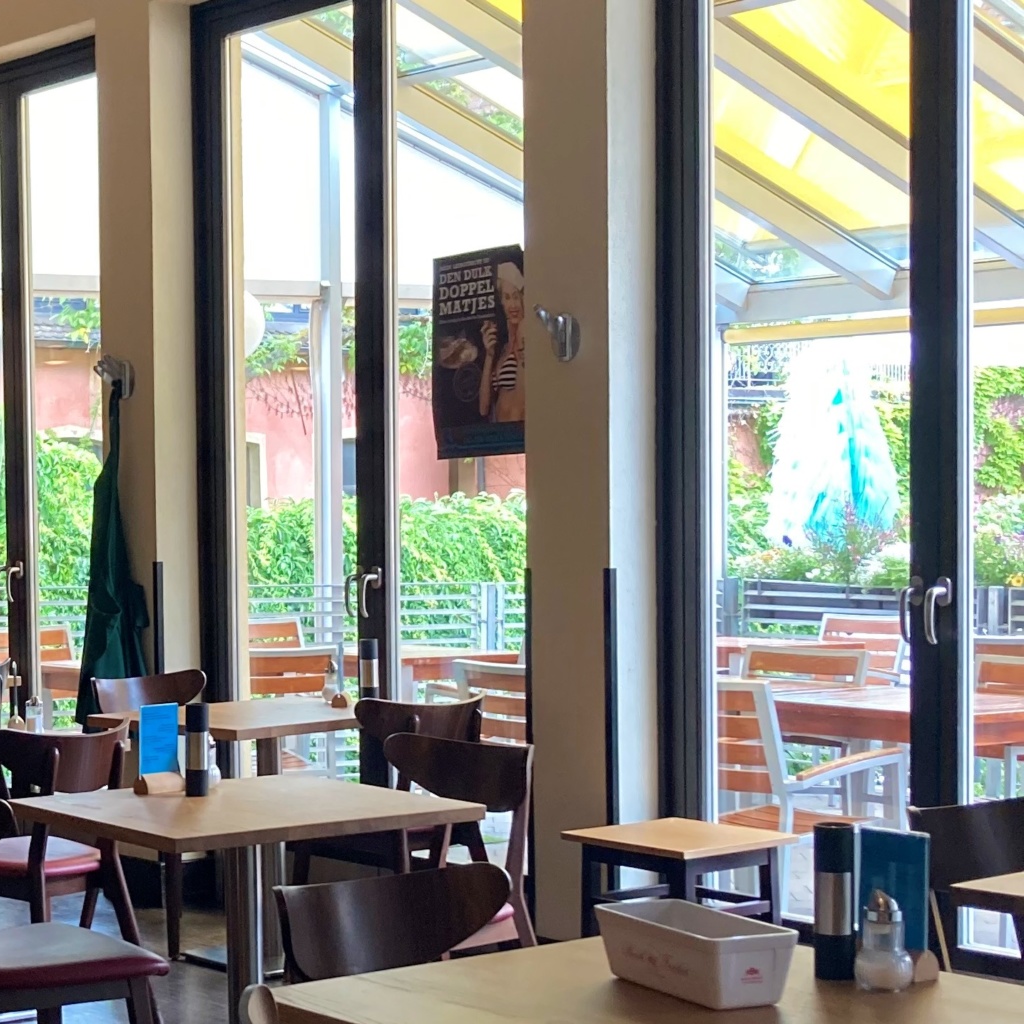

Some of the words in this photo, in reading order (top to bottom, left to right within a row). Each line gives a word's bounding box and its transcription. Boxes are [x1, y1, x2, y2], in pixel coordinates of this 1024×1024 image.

[439, 271, 461, 285] DEN
[464, 265, 492, 281] DULK
[439, 279, 494, 300] DOPPEL
[439, 295, 495, 315] MATJES
